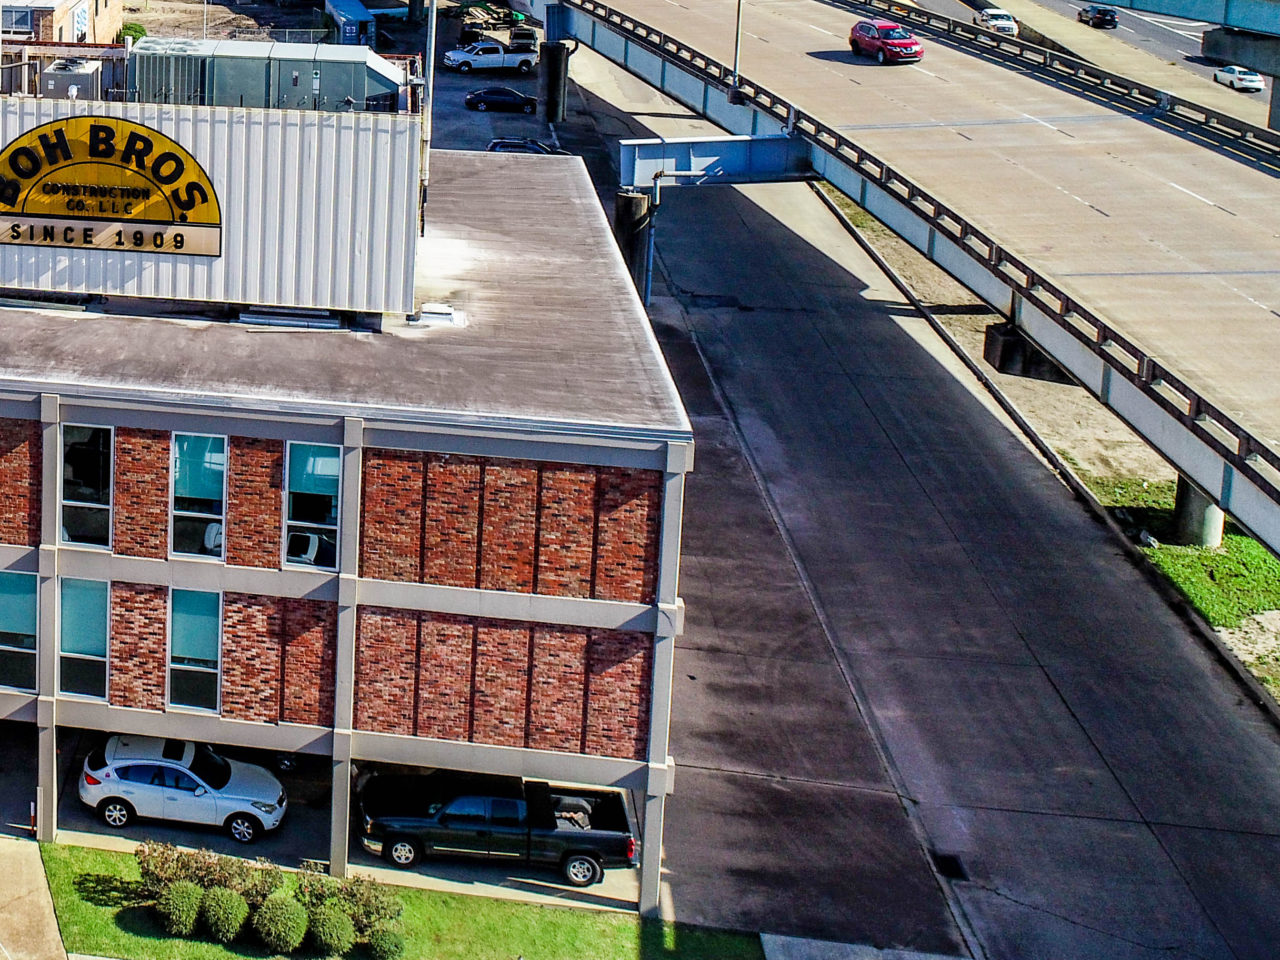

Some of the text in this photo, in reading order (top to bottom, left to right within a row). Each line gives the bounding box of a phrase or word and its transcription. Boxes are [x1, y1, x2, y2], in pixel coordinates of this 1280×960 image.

[41, 181, 151, 201] CONSTRUCTION
[10, 223, 186, 250] SINCE 1909
